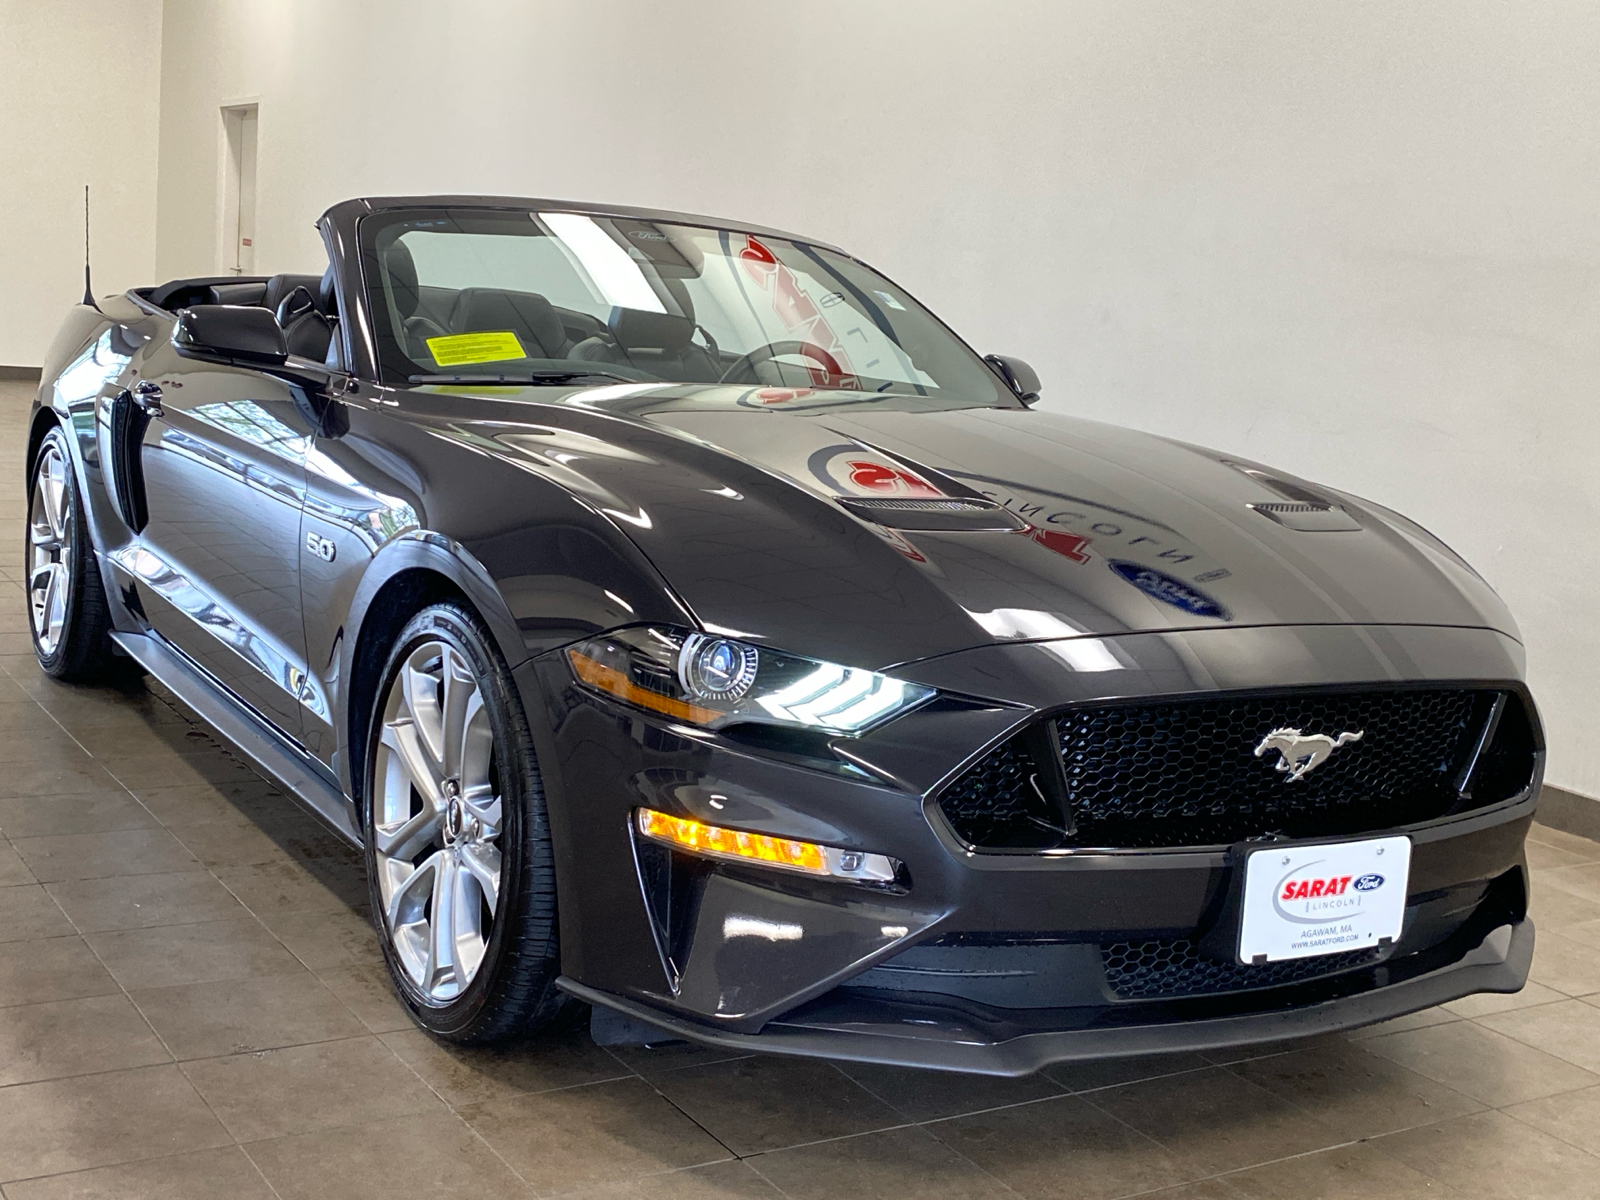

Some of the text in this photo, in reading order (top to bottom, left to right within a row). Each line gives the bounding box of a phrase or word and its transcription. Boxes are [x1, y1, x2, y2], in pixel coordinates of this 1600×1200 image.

[1281, 875, 1381, 901] SARAT Ford
[1312, 898, 1355, 911] LINCOLN
[1300, 924, 1353, 940] AGAWAM, MA
[1291, 934, 1359, 949] WWW.SARATFORD.COM
